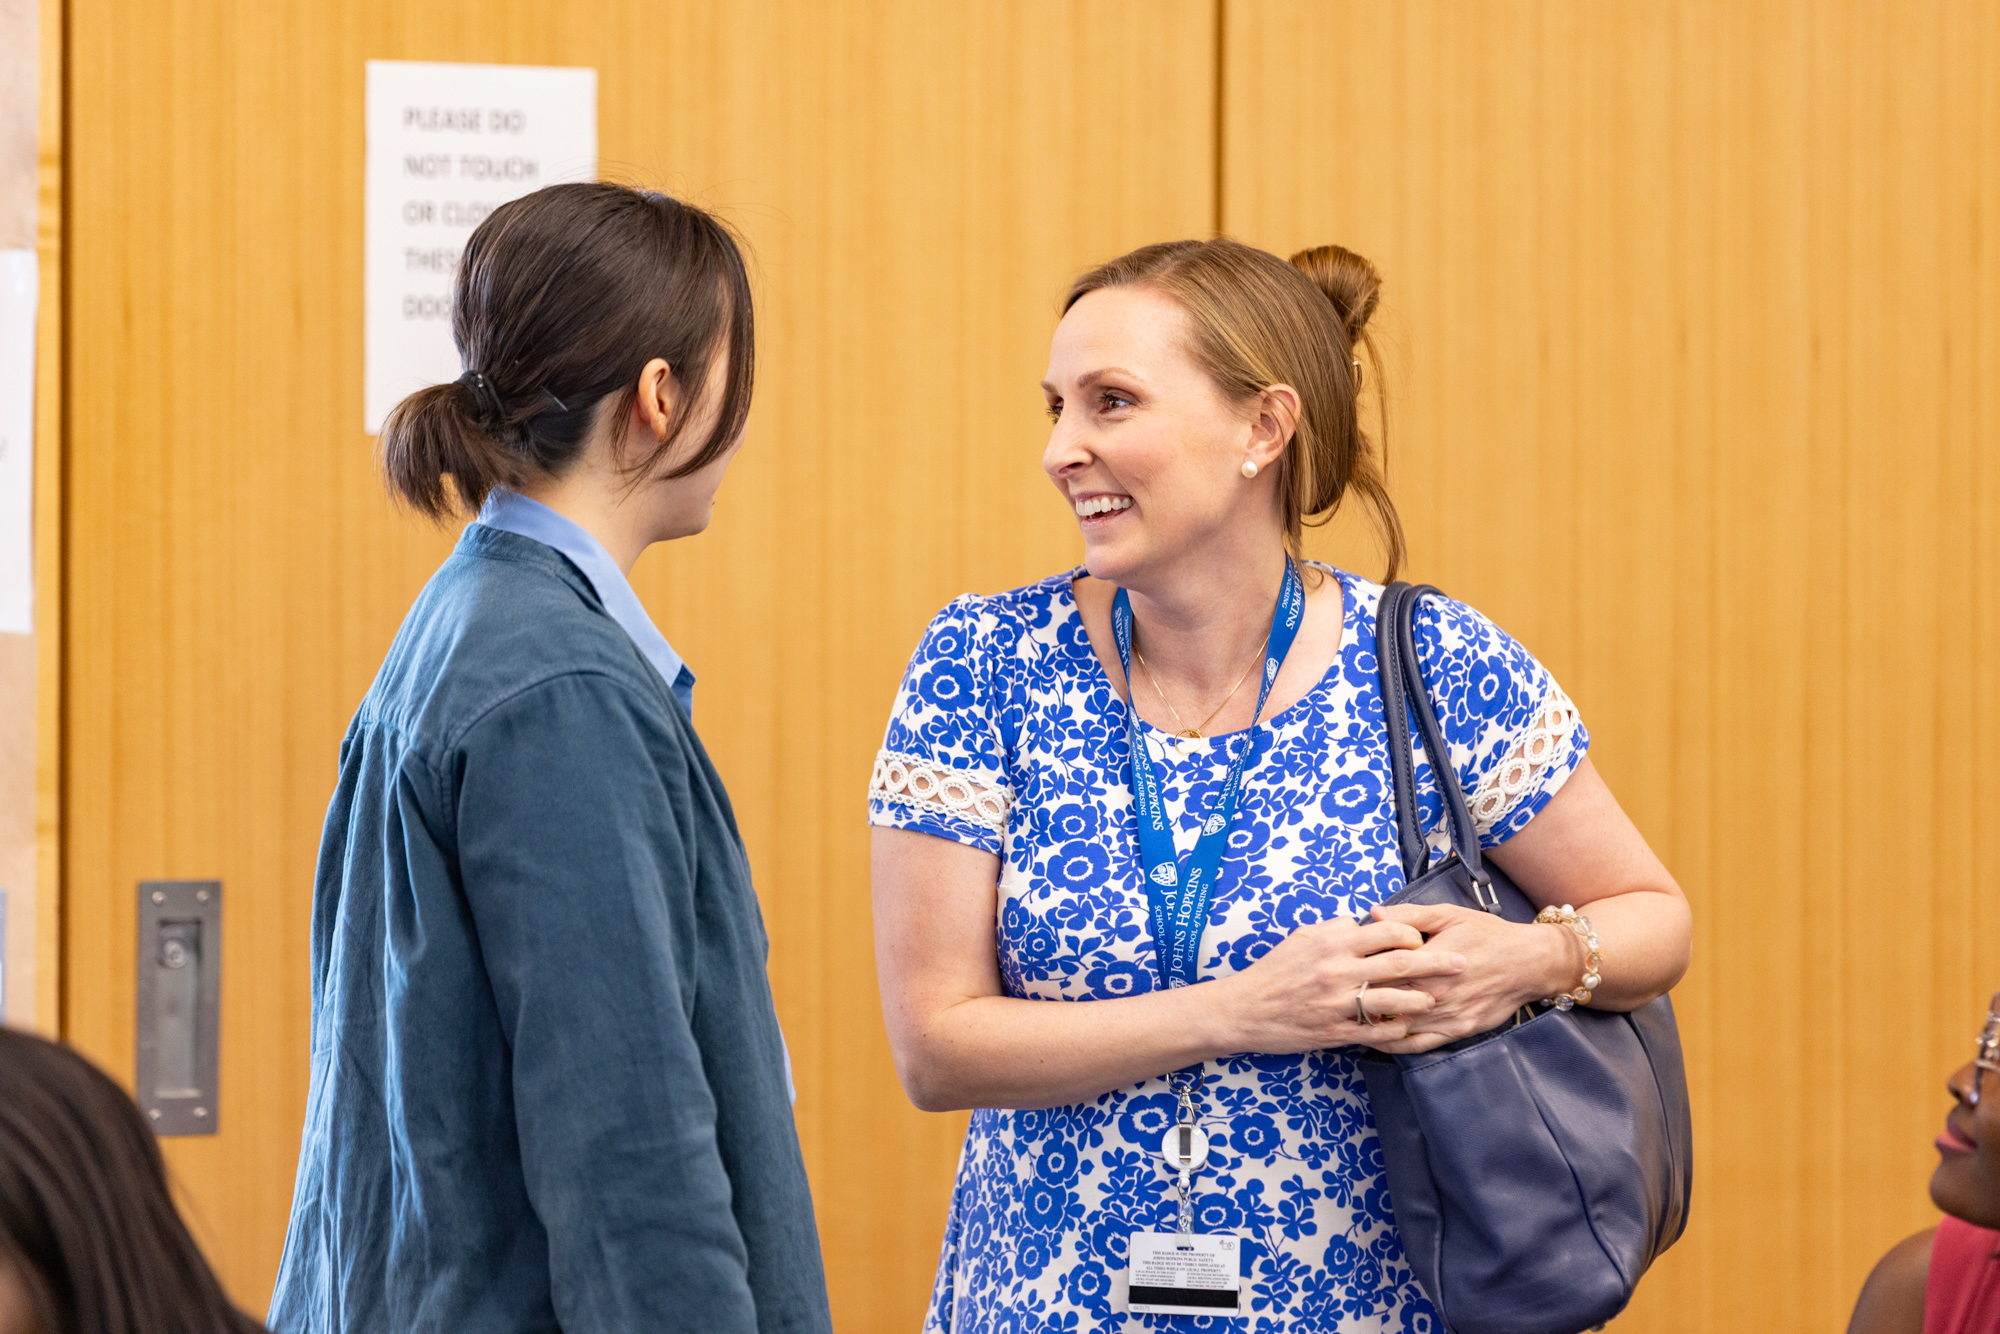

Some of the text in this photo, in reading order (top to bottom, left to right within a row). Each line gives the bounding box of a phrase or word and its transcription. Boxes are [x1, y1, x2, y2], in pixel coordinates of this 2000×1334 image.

[403, 107, 527, 134] PLEASE DO
[403, 154, 540, 181] NOT TOUCH
[402, 201, 499, 227] OR CLO
[404, 248, 460, 273] THES
[1282, 576, 1292, 609] NURSING
[1134, 729, 1164, 831] JOHNS HOPKINS
[1214, 771, 1234, 811] JOHNS
[1137, 780, 1147, 816] NURSING
[1154, 905, 1165, 938] SCHOOL
[1170, 867, 1202, 976] JOHNS HOPKINS
[1187, 883, 1209, 963] SCHOOL of NURSING
[1158, 938, 1167, 948] of
